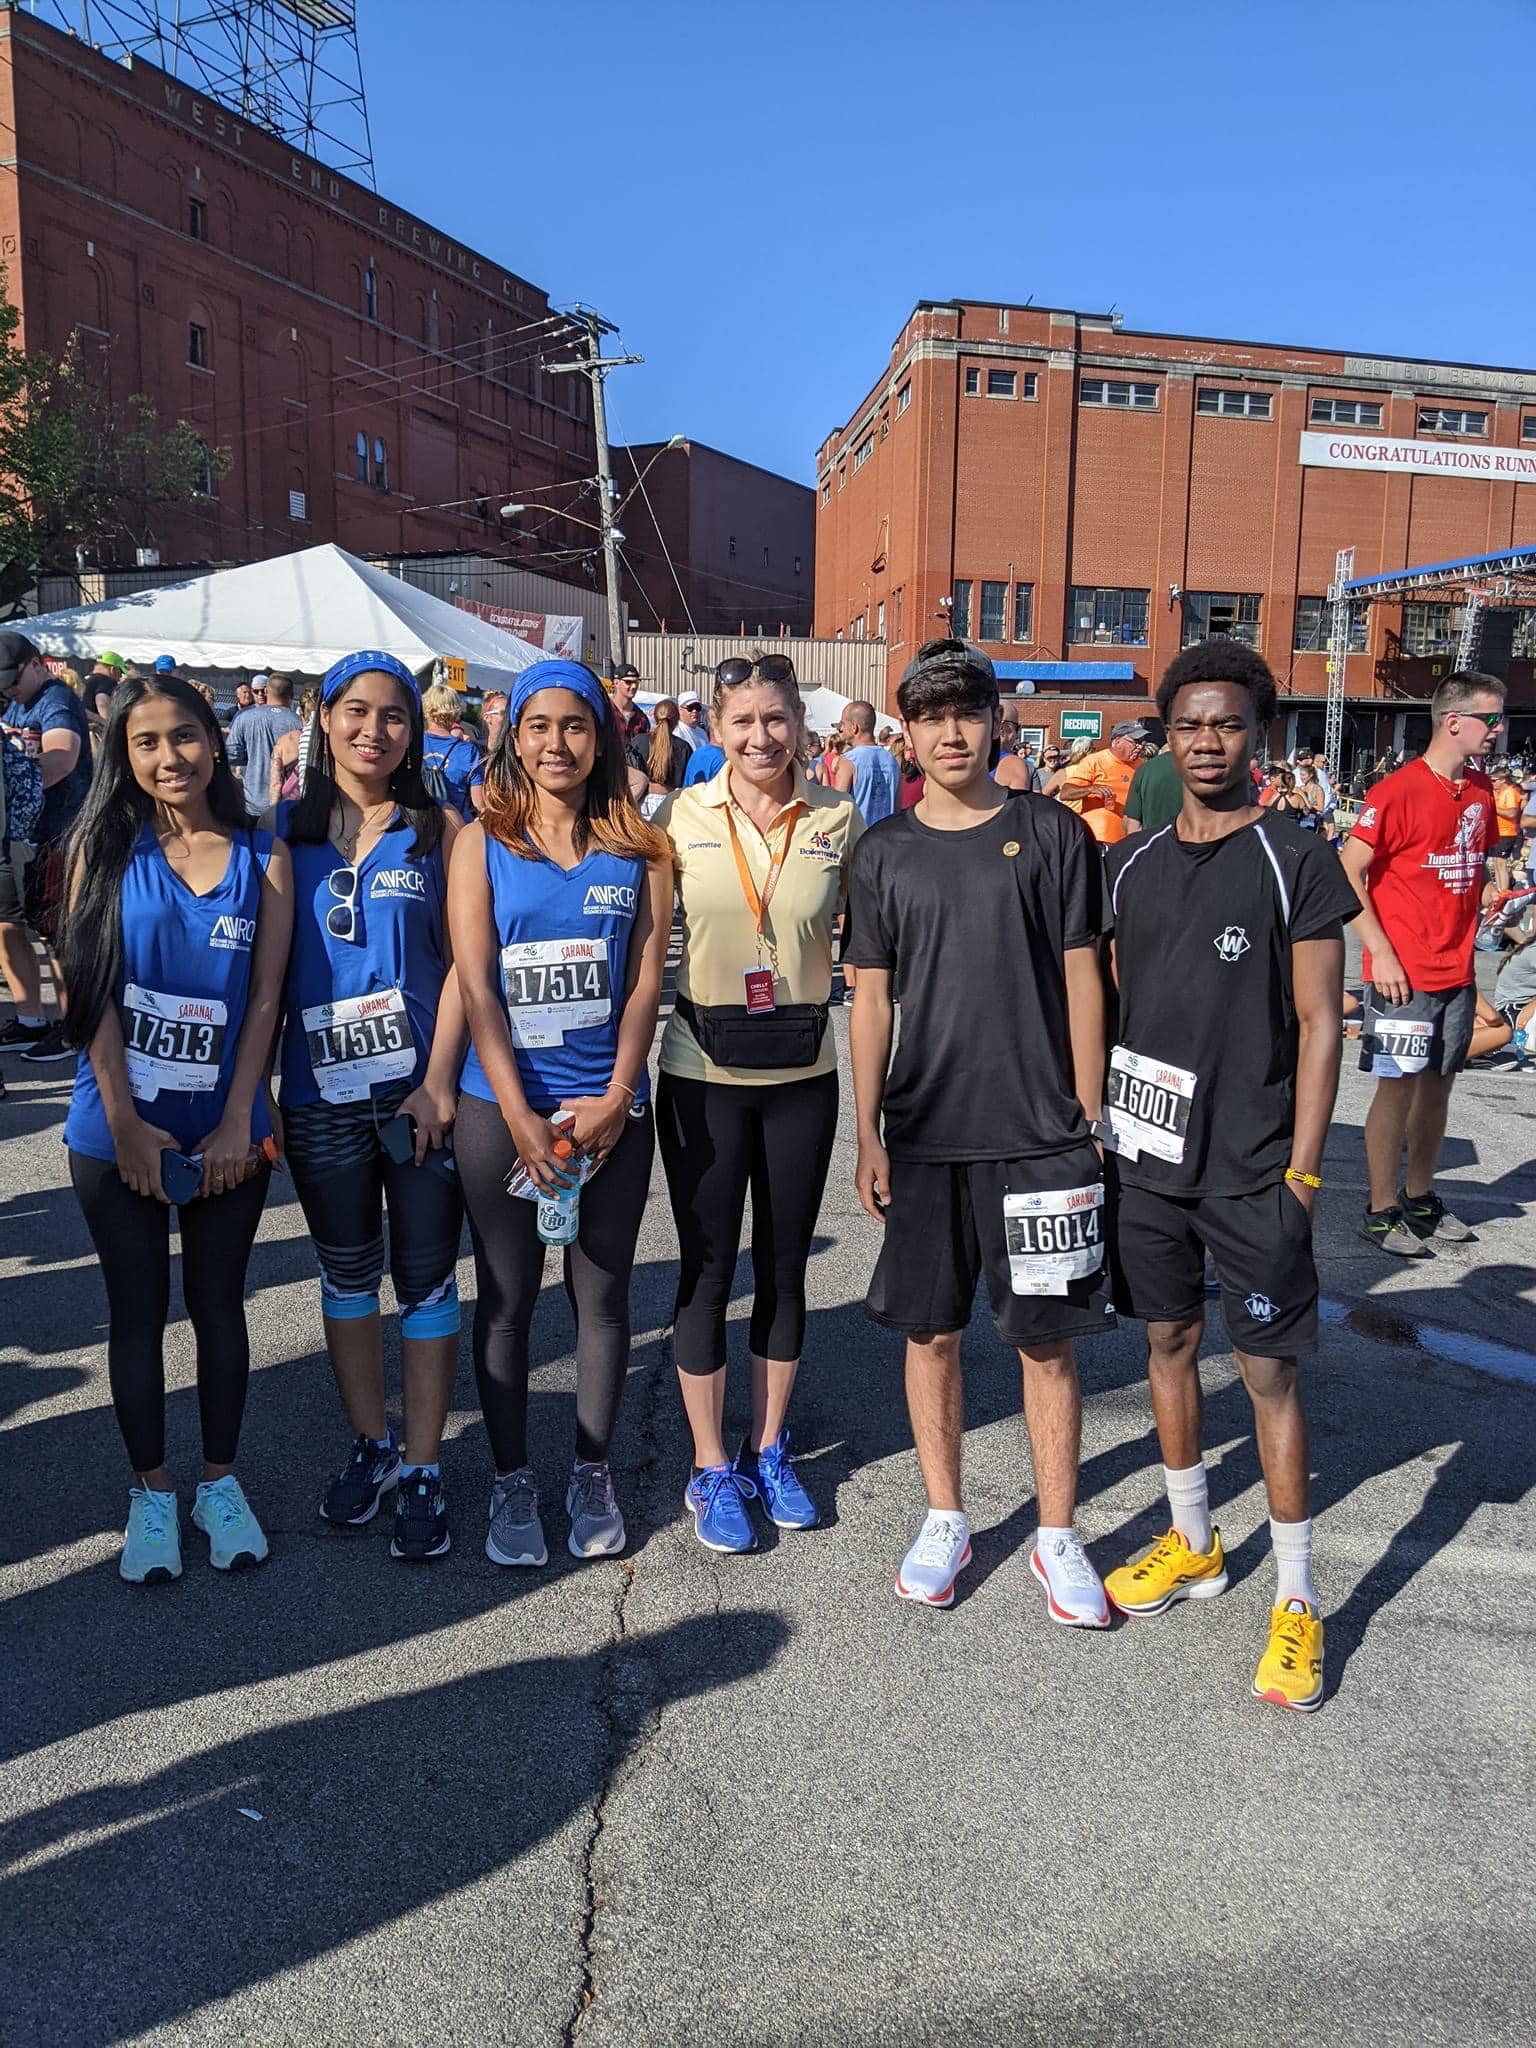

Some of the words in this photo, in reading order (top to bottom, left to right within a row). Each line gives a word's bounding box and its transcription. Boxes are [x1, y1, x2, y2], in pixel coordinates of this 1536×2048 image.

[164, 84, 245, 146] WEST
[291, 157, 340, 199] END
[378, 207, 482, 279] BREWING
[1350, 359, 1393, 377] WEST
[1404, 365, 1439, 381] END
[1450, 369, 1525, 390] BREWING
[1329, 442, 1491, 470] CONGRATULATIONS
[448, 664, 465, 684] EXIT
[1064, 718, 1099, 730] RECEIVING
[687, 842, 722, 850] Committee
[1427, 851, 1459, 865] Tunnel
[561, 944, 596, 961] SARANAC
[516, 962, 600, 1003] 17514
[177, 1003, 216, 1022] SARANAC
[356, 998, 393, 1018] SARANAC
[129, 1011, 214, 1062] 17513
[317, 1014, 403, 1065] 17515
[1380, 1034, 1428, 1056] 17785
[1114, 1072, 1179, 1132] 16001
[1018, 1209, 1100, 1253] 16014
